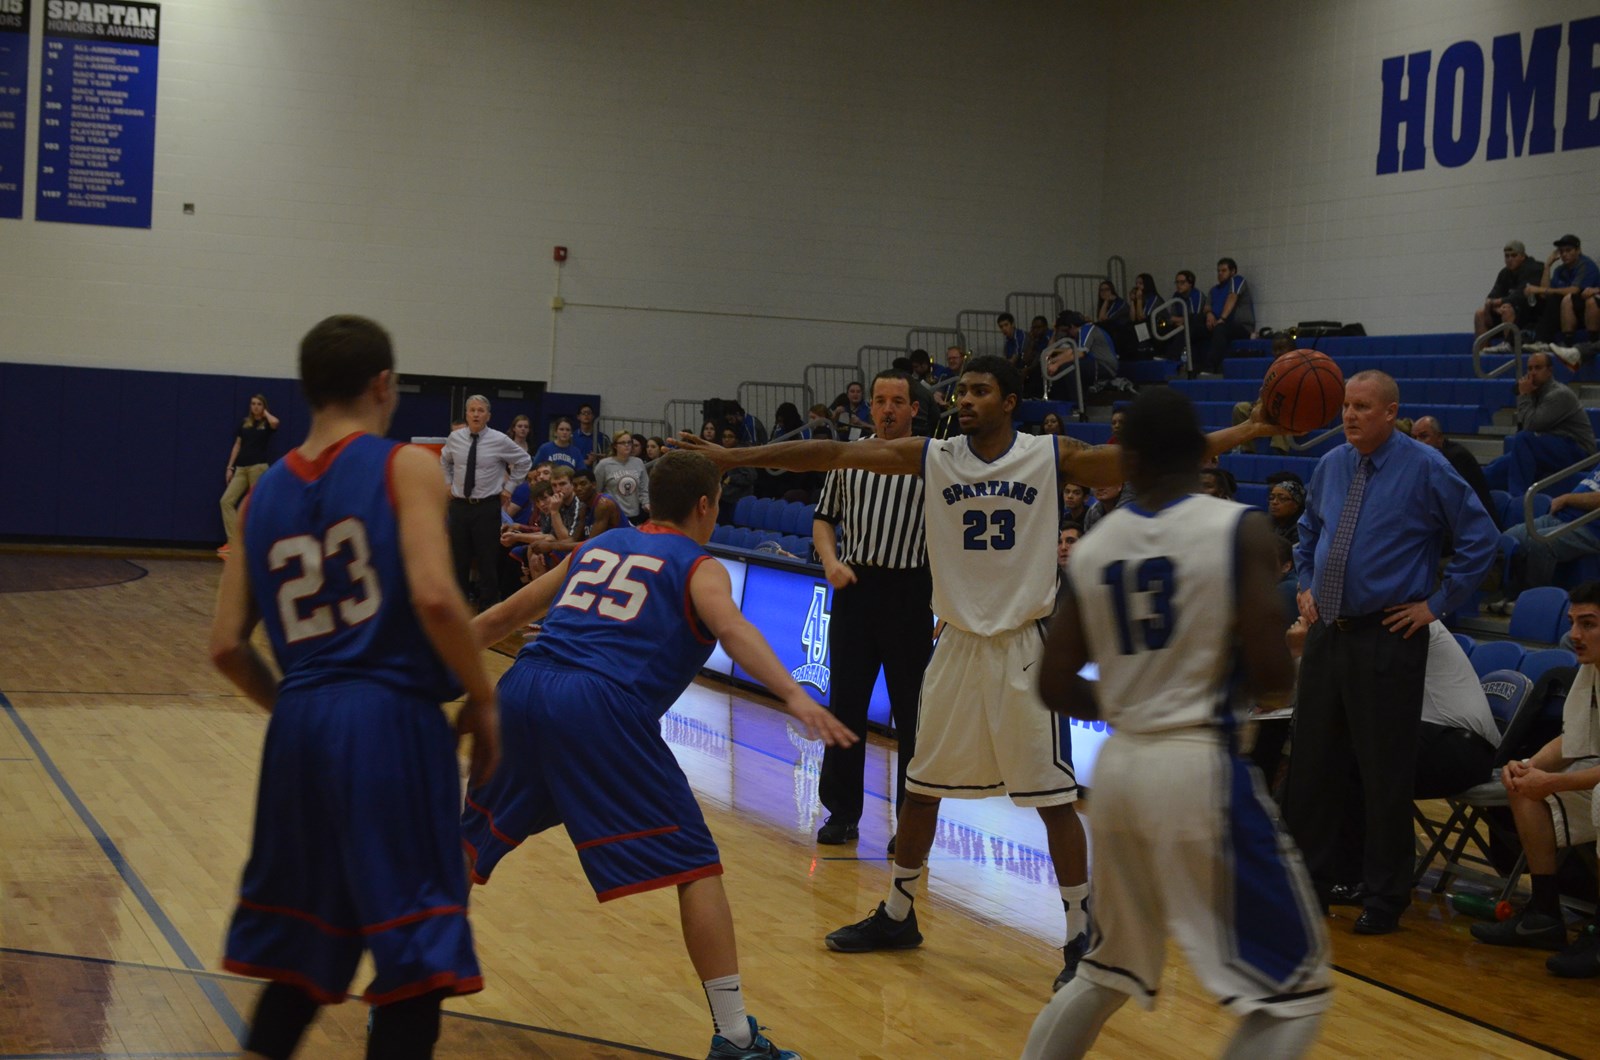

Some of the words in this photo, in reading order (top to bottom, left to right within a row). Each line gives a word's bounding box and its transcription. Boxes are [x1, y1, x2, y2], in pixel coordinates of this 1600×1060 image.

[48, 1, 157, 28] SPARTAN
[48, 19, 94, 34] HONORS
[96, 24, 105, 36] &
[107, 25, 156, 40] AWARDS
[73, 78, 89, 87] THE
[91, 79, 112, 88] YEAR
[72, 95, 83, 103] OF
[84, 96, 100, 104] THE
[102, 97, 124, 106] YEAR
[1376, 15, 1600, 176] HOME
[70, 121, 123, 132] CONFERENCE
[70, 135, 86, 143] THE
[87, 136, 109, 145] YEAR
[69, 144, 122, 155] CONFERENCE
[69, 159, 85, 167] THE
[86, 160, 108, 168] YEAR
[108, 154, 120, 162] OF
[68, 168, 121, 179] CONFERENCE
[85, 184, 107, 192] YEAR
[548, 452, 576, 467] AURORA
[942, 480, 1038, 505] SPARTANS
[963, 509, 1015, 550] 23
[267, 516, 383, 644] 23
[555, 548, 665, 622] 25
[1103, 556, 1175, 656] 13
